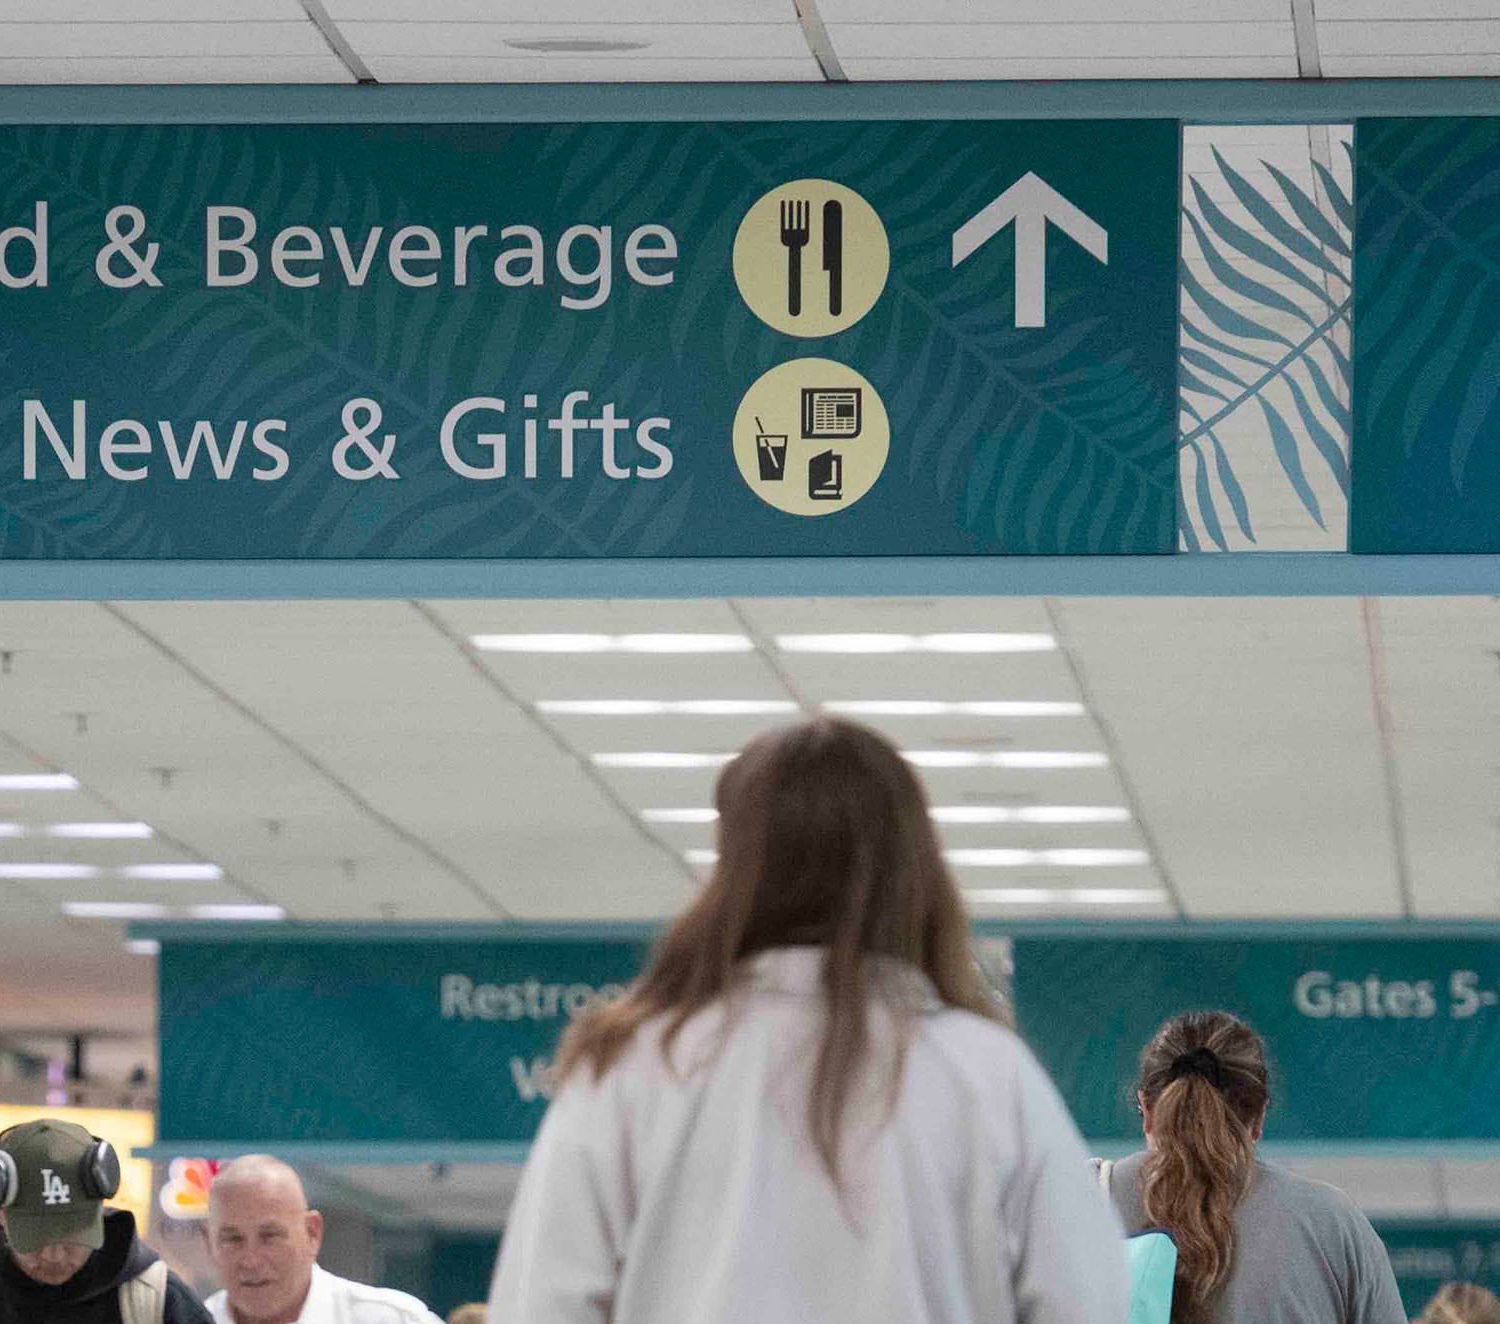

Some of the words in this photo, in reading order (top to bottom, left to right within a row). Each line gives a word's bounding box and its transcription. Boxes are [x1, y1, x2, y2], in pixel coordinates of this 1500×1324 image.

[95, 204, 164, 289] &
[206, 205, 679, 311] Beverage
[22, 399, 291, 482] News
[331, 396, 400, 481] &
[439, 391, 674, 481] Gifts
[440, 973, 628, 1021] Restroo
[1295, 968, 1437, 1019] Gates
[40, 1168, 71, 1205] LA
